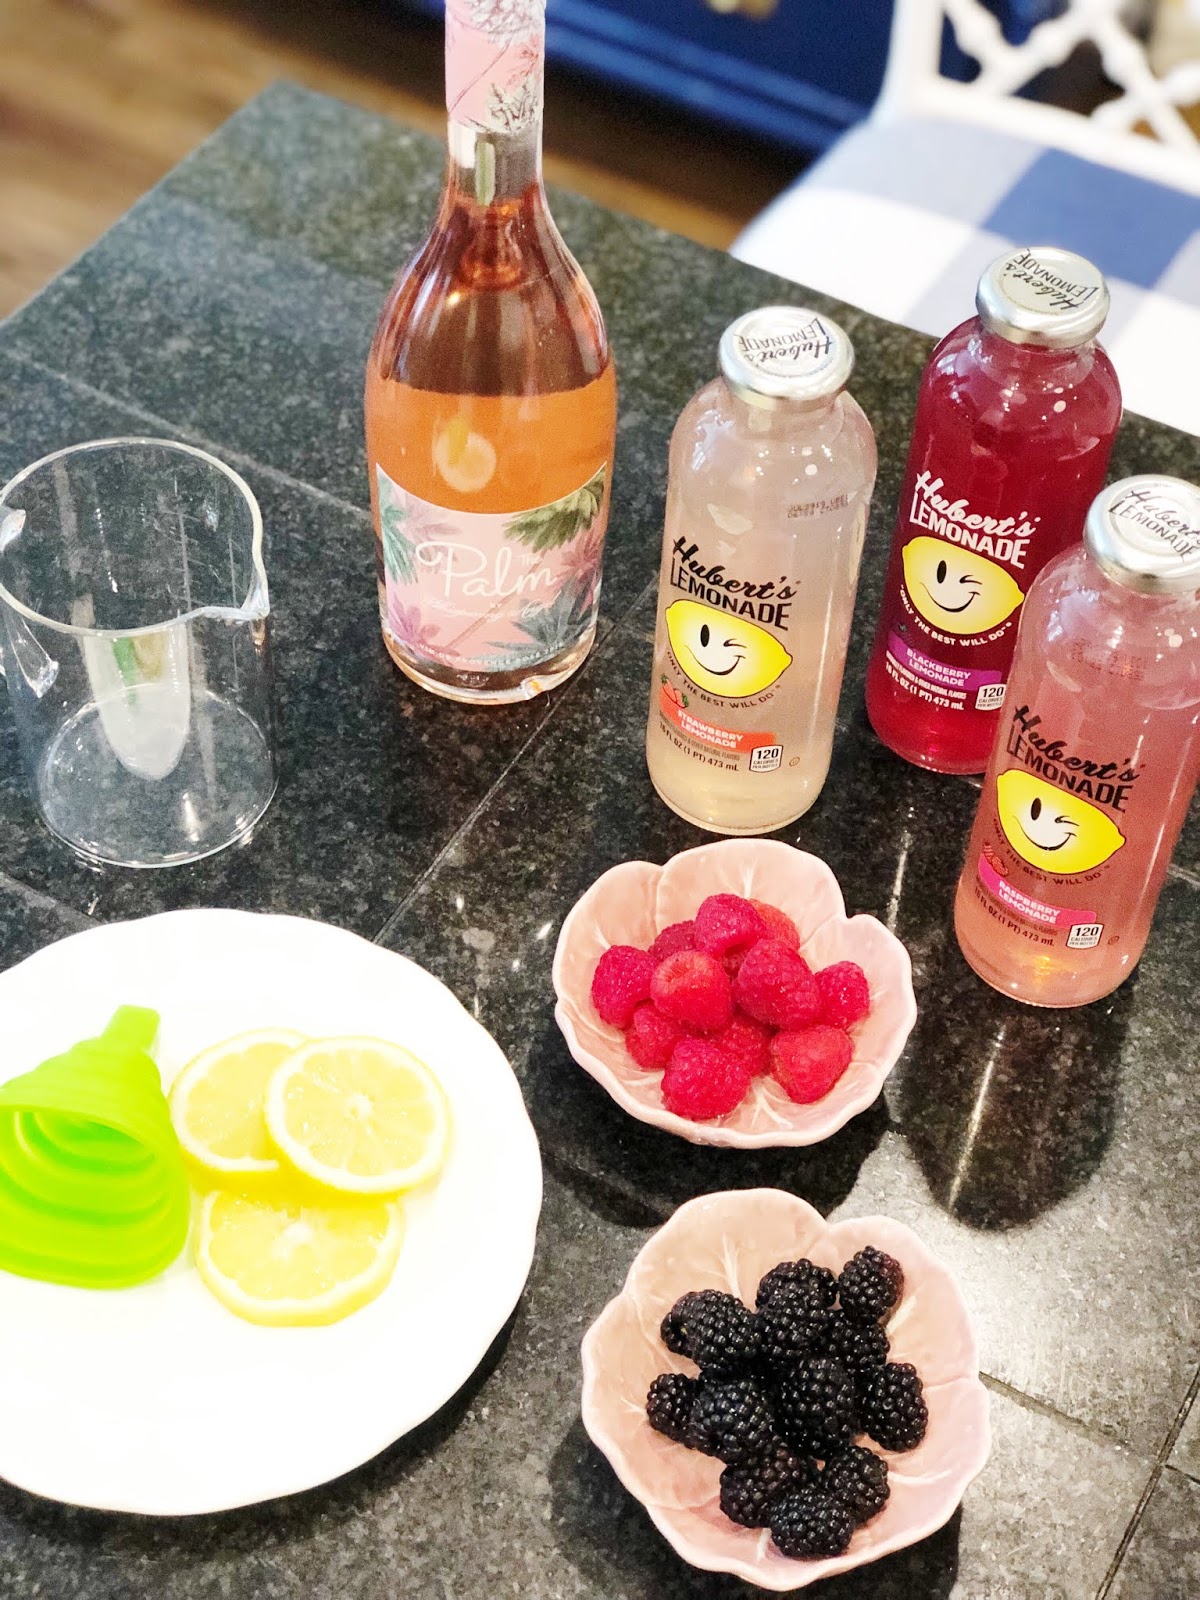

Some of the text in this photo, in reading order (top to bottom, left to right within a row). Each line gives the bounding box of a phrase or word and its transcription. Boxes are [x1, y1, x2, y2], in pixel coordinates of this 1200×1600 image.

[1003, 262, 1084, 310] Hubert's
[1013, 249, 1099, 301] LEMONADE
[733, 317, 826, 352] LEMONADE
[915, 470, 1036, 537] Hubert's
[909, 491, 1030, 569] LEMONADE
[416, 540, 557, 597] Palm
[672, 536, 797, 599] Hubert's
[670, 557, 792, 631] LEMONADE
[914, 616, 930, 634] THE
[930, 631, 956, 645] BEST
[959, 637, 988, 646] WILL
[906, 647, 971, 679] BLACKBERRY
[909, 658, 964, 687] LEMONADE
[683, 679, 697, 695] THE
[700, 693, 724, 707] BEST
[729, 700, 757, 708] WILL
[892, 669, 899, 682] FL
[919, 689, 932, 703] PT)
[933, 696, 949, 708] 473
[951, 702, 964, 710] mL
[983, 686, 1004, 697] 120
[677, 709, 743, 742] STRAWBERRY
[681, 719, 737, 748] LEMONADE
[757, 748, 779, 760] 120
[1013, 705, 1139, 782] Hubert's
[693, 751, 706, 763] PT)
[707, 758, 723, 768] 473
[726, 764, 739, 772] mL
[1007, 723, 1133, 813] LEMONADE
[1023, 866, 1046, 882] BEST
[998, 889, 1057, 924] LEMONADE
[999, 880, 1060, 917] RASPBERRY
[1007, 921, 1020, 934] PT)
[1022, 930, 1039, 942] 473
[1041, 938, 1054, 946] mL
[1075, 926, 1099, 936] 120
